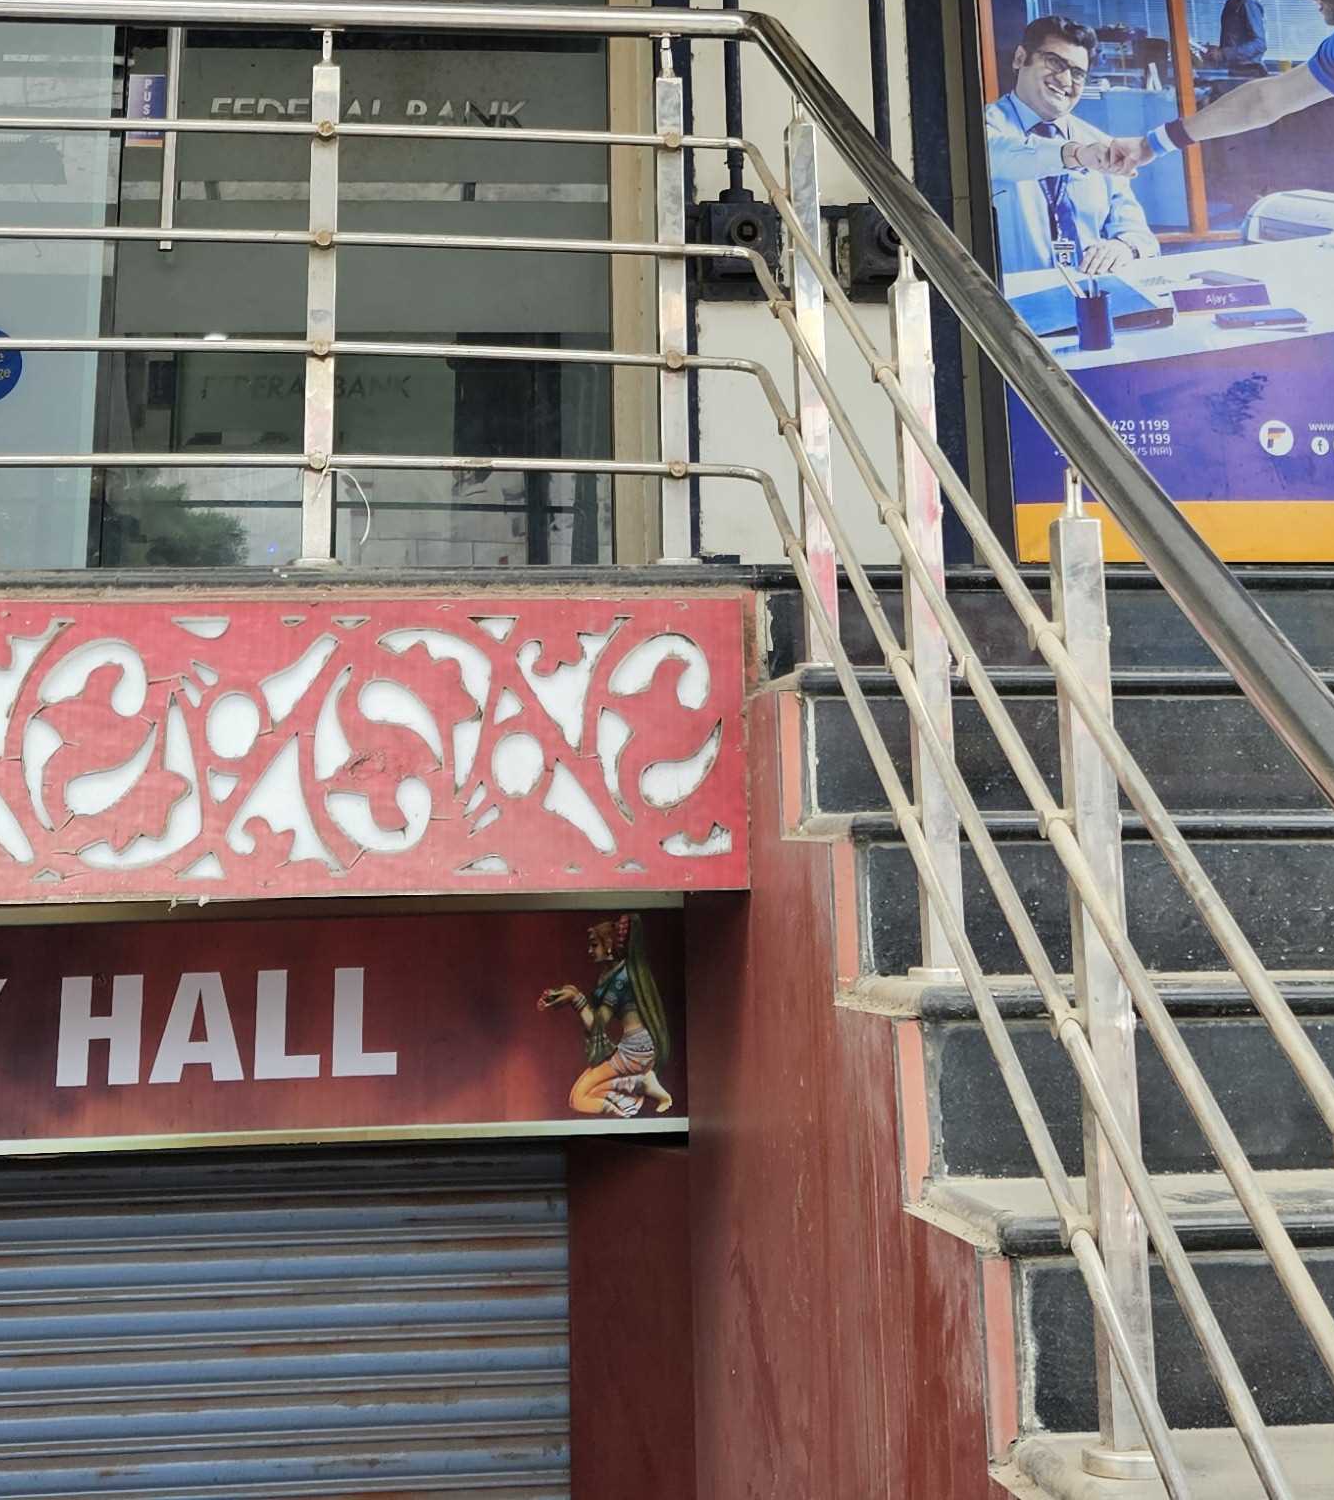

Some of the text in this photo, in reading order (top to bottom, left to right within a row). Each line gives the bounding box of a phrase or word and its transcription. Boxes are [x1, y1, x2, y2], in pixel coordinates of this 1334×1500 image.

[1139, 420, 1169, 431] 1199
[1140, 434, 1170, 444] 1199
[57, 967, 398, 1087] HALL
